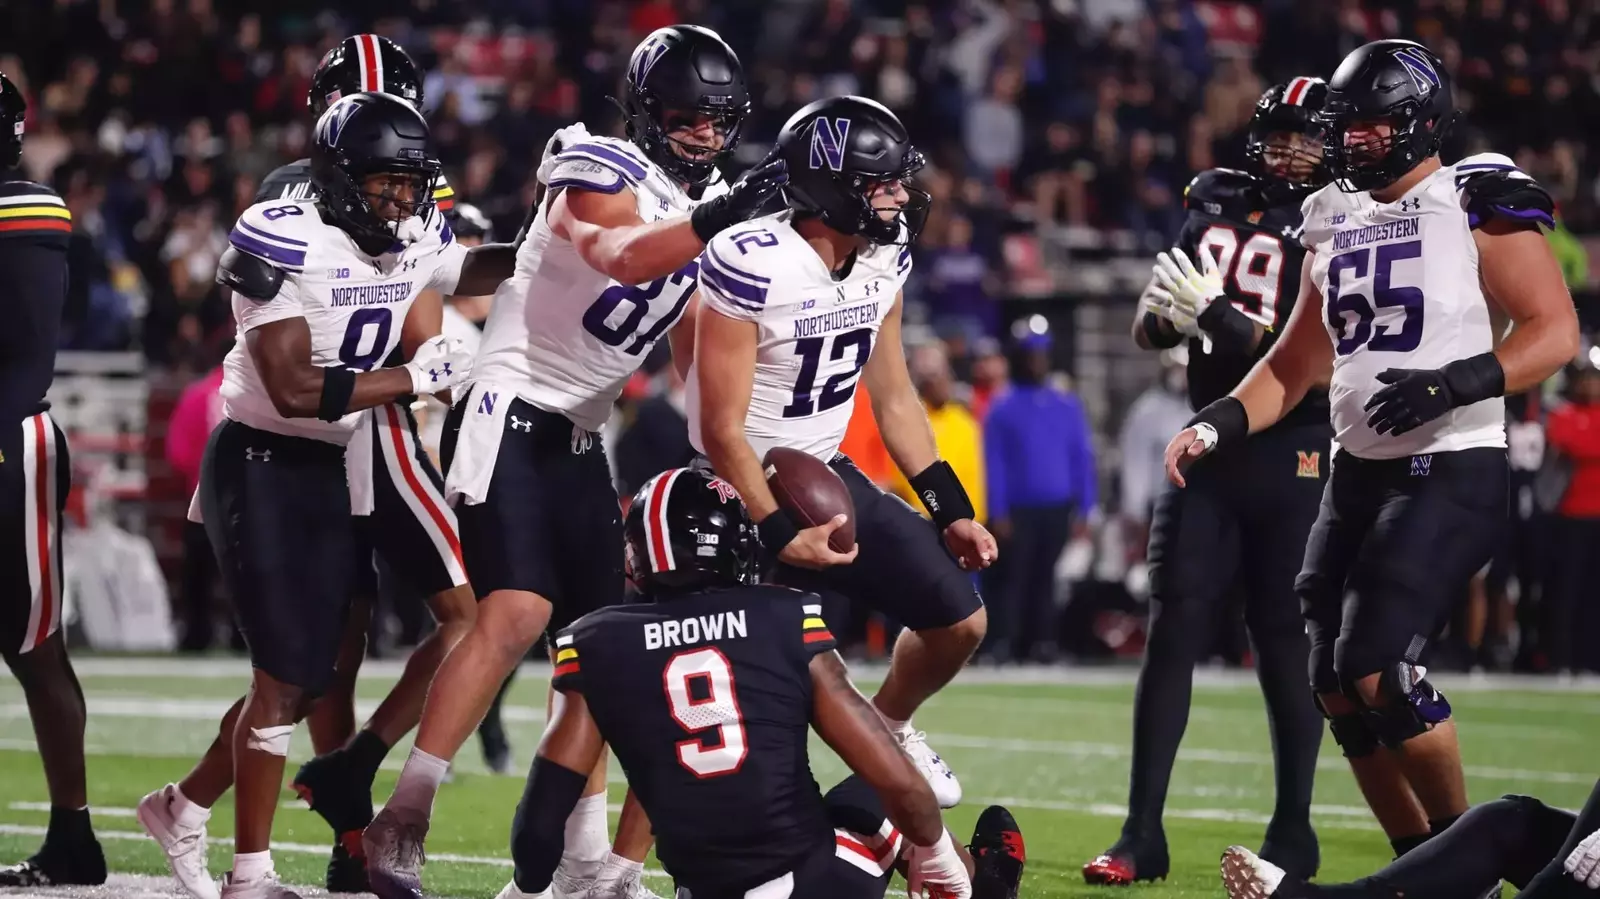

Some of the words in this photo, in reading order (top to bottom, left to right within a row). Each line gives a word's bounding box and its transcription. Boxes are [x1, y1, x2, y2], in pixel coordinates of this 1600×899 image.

[1391, 46, 1443, 97] N
[808, 116, 851, 172] N
[262, 205, 304, 221] 8
[728, 226, 779, 256] 12
[1331, 216, 1420, 251] NORTHWESTERN
[1197, 225, 1286, 325] 99
[330, 280, 413, 308] NORTHWESTERN
[836, 285, 846, 303] N
[1325, 239, 1425, 356] 65
[793, 302, 879, 338] NORTHWESTERN
[782, 327, 873, 419] 12
[477, 390, 499, 416] N
[1295, 450, 1321, 478] M
[1410, 454, 1433, 476] N
[643, 609, 749, 651] BROWN
[662, 645, 749, 780] 9
